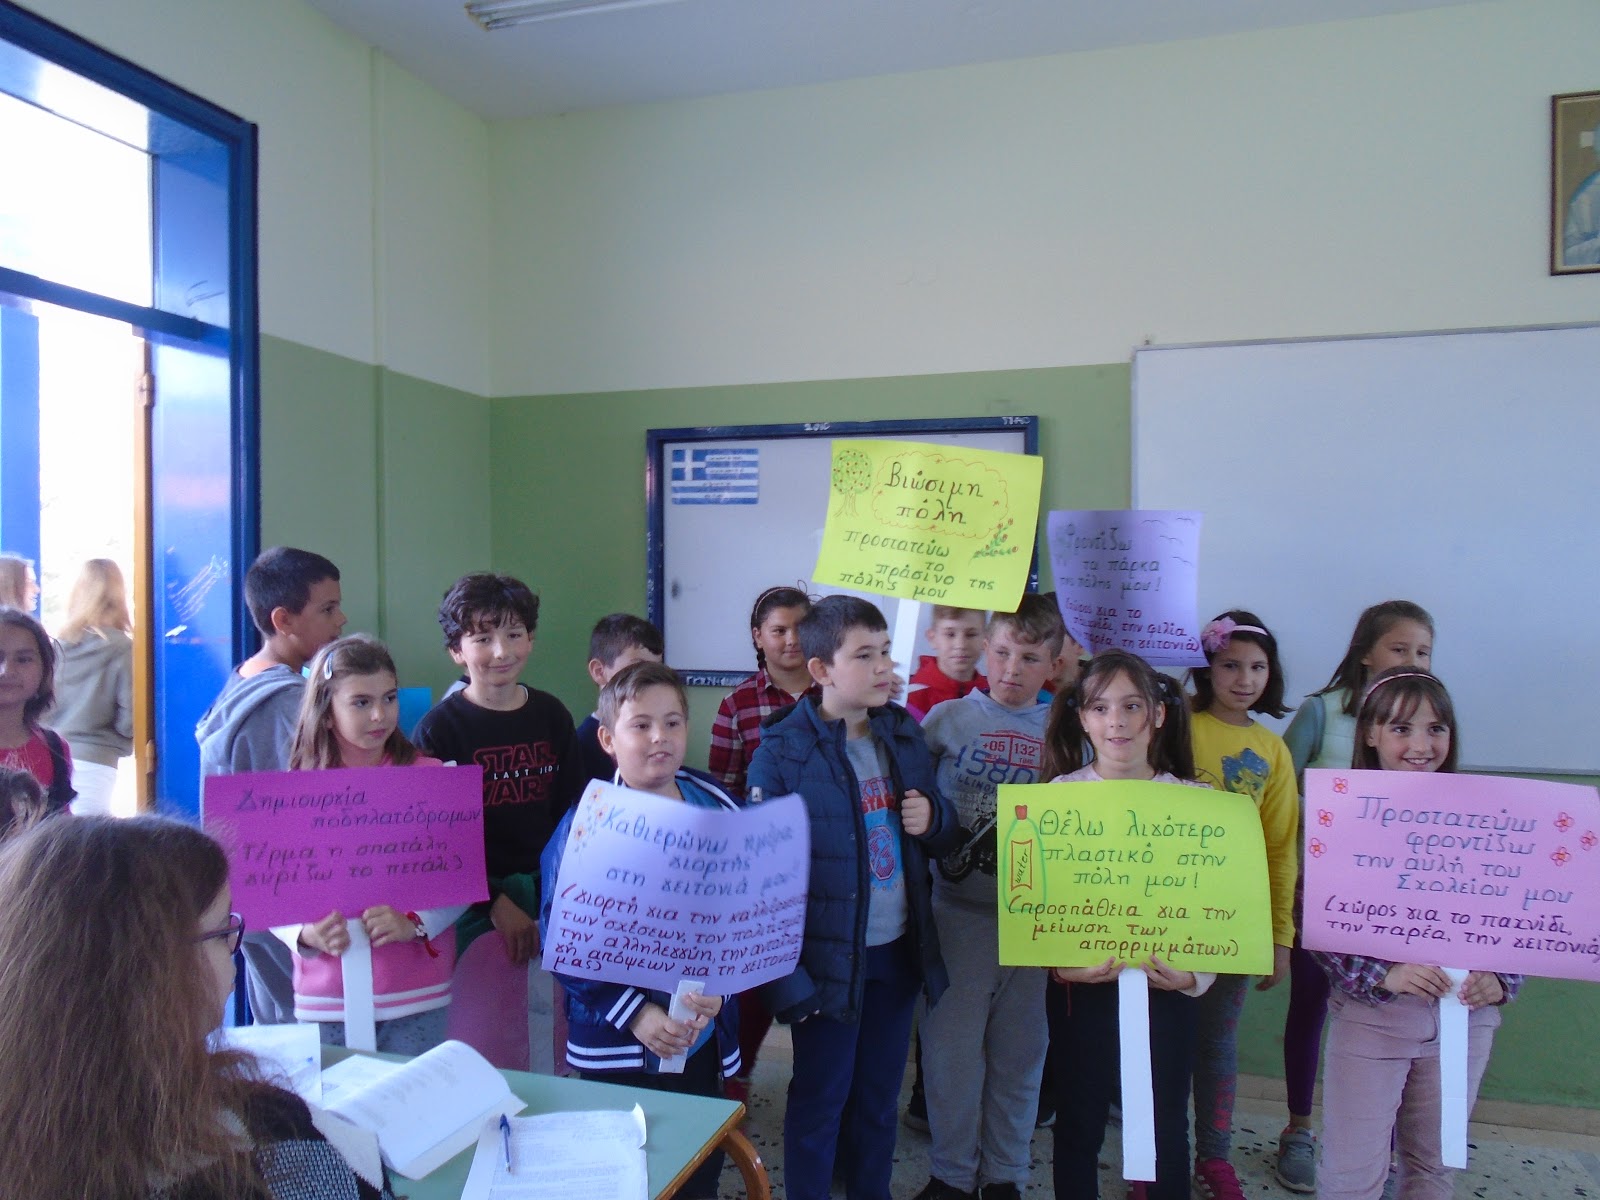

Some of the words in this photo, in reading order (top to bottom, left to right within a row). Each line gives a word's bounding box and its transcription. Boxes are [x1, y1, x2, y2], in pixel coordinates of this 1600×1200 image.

[885, 461, 984, 509] Βιώσιμη
[897, 499, 967, 524] πόλη
[843, 530, 950, 557] προστατεύω
[875, 564, 955, 584] πράσινο
[969, 578, 996, 590] της
[925, 561, 945, 572] το
[1107, 556, 1160, 579] πάρκα
[839, 571, 897, 591] πόλης
[912, 584, 948, 600] μου
[1120, 577, 1162, 600] μου!
[1127, 609, 1143, 619] το
[1121, 622, 1143, 633] την
[1147, 622, 1188, 639] φιλία
[473, 741, 558, 774] STAR
[494, 769, 530, 780] LAST
[235, 786, 369, 814] Δημιουργία
[311, 801, 482, 829] ποδηλατόδρομων
[1356, 796, 1538, 833] Προστατεύω
[600, 804, 729, 855] Καθιερώνω
[1039, 809, 1105, 837] Θέλω
[1126, 809, 1226, 848] λιγότερο
[1041, 842, 1155, 864] πλαστικό
[1177, 853, 1227, 867] στην
[1406, 831, 1537, 855] φροντίζω
[349, 864, 374, 878] το
[668, 855, 752, 879] γιορτής
[1015, 848, 1029, 884] water
[1353, 854, 1395, 869] την
[1404, 854, 1465, 874] αυλή
[1481, 863, 1522, 879] του
[606, 867, 646, 886] στη
[662, 876, 749, 896] γειτονιά
[1073, 866, 1130, 885] πόλη
[1145, 871, 1199, 898] μου!
[1396, 874, 1511, 898] Σχολείου
[1523, 887, 1574, 911] μου
[561, 883, 638, 917] (γιορτή
[646, 905, 679, 920] για
[690, 911, 722, 925] την
[1008, 894, 1143, 921] (προσπάθεια
[1157, 903, 1191, 919] για
[1202, 907, 1237, 920] την
[1324, 894, 1397, 921] (χώρος
[1406, 906, 1442, 922] για
[1450, 911, 1471, 925] το
[561, 910, 599, 926] των
[694, 932, 727, 944] τον
[1032, 917, 1112, 940] μείωση
[1126, 923, 1169, 936] των
[1326, 919, 1363, 933] την
[1464, 931, 1502, 945] την
[560, 927, 594, 943] την
[721, 946, 749, 962] την
[1080, 936, 1240, 962] απορριμμάτων)
[553, 955, 603, 972] μας)
[555, 941, 577, 956] γή
[588, 949, 676, 972] απόψεων
[681, 965, 710, 977] για
[717, 965, 736, 976] τη
